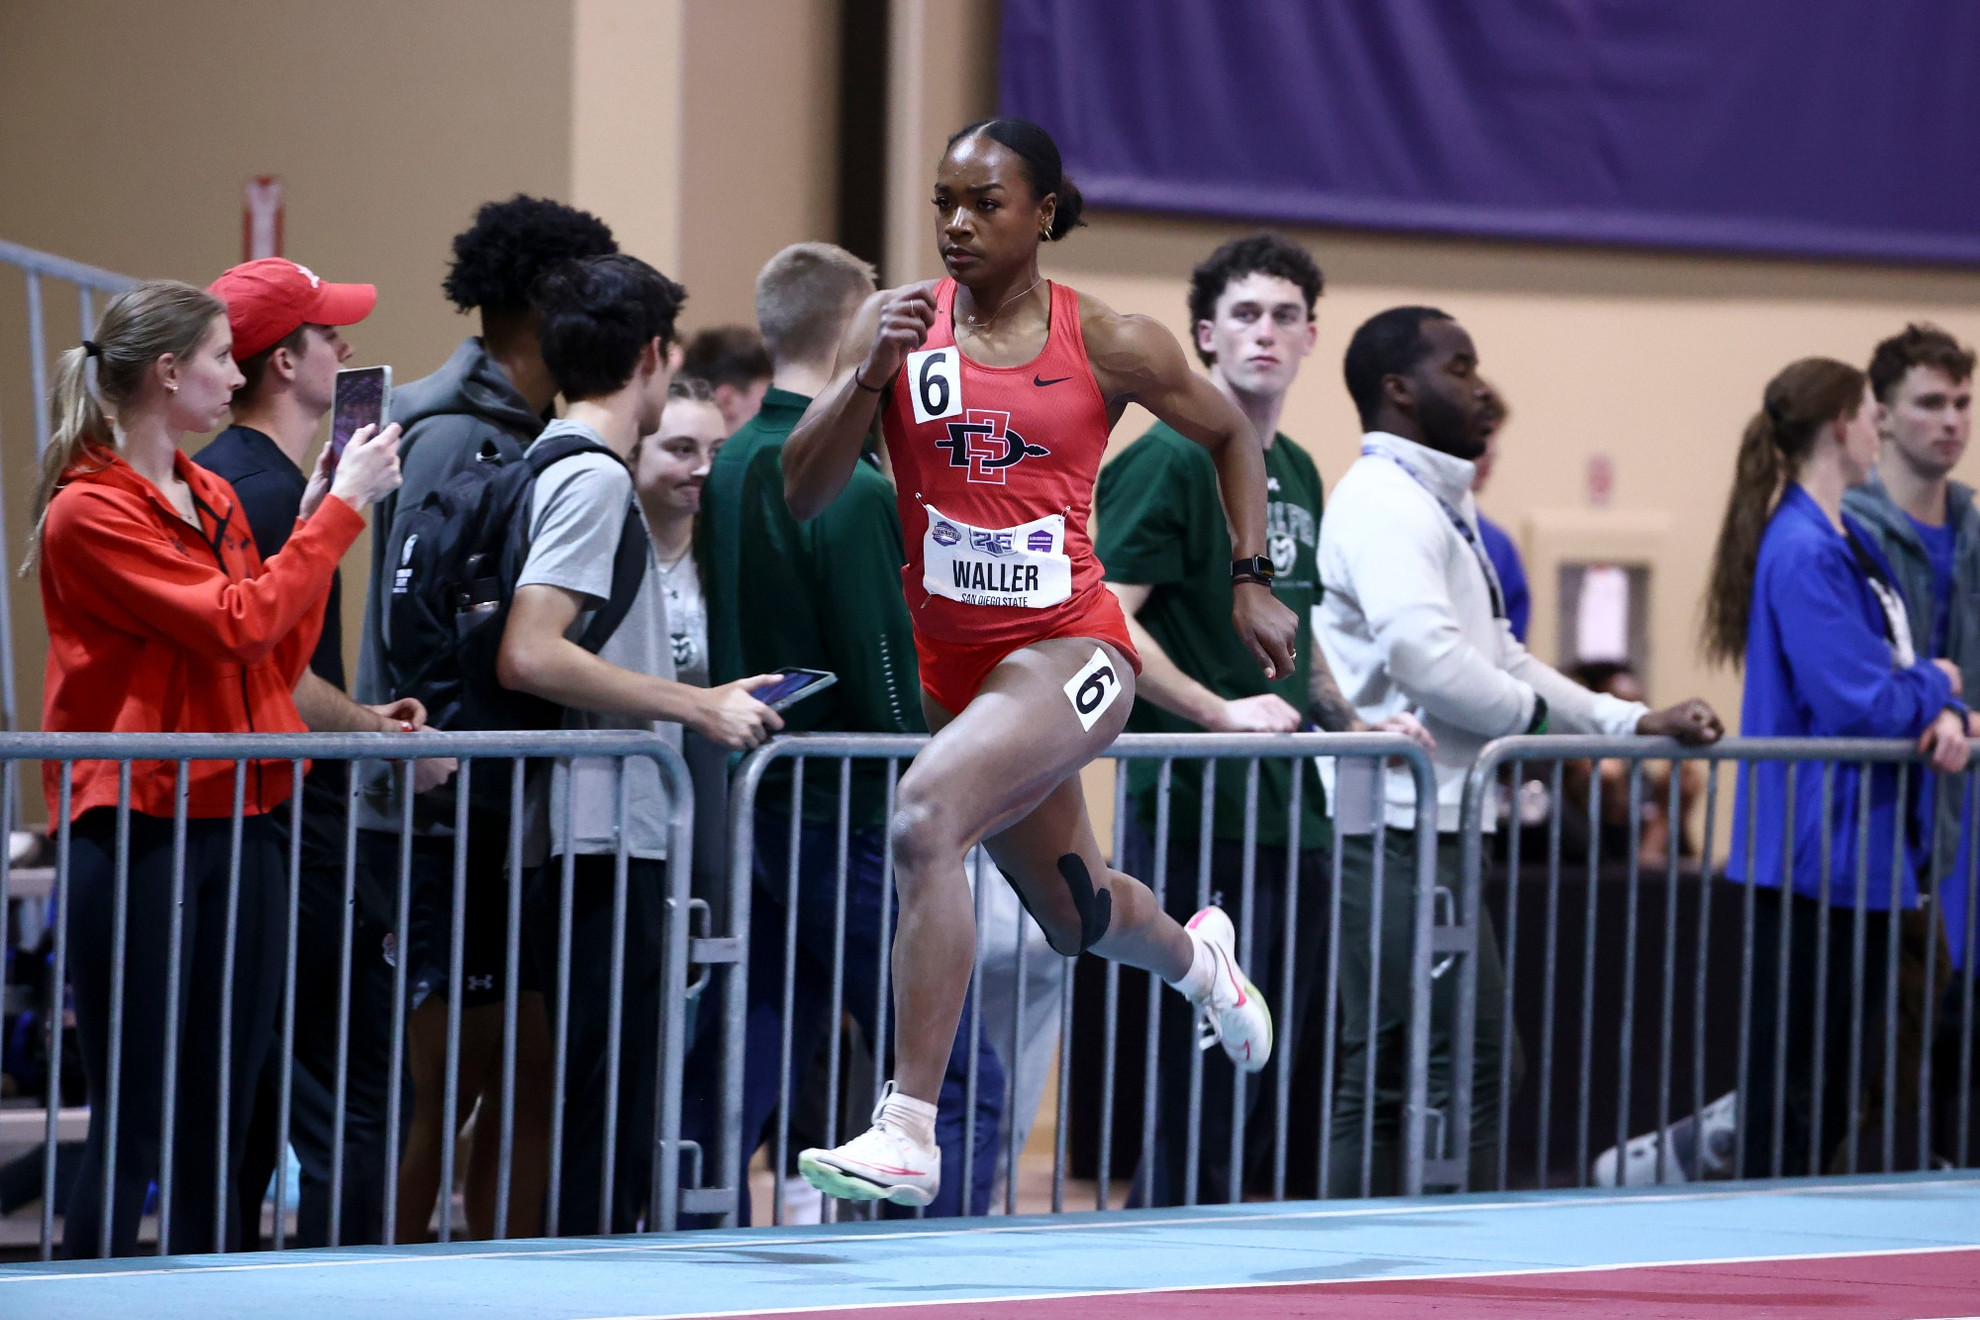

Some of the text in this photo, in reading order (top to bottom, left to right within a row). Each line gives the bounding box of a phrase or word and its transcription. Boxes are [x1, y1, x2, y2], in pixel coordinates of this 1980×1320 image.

[919, 352, 950, 416] 6
[973, 530, 1012, 550] 25
[952, 559, 1039, 592] WALLER
[960, 592, 1029, 608] SAN DIEGO STATE
[1076, 665, 1115, 714] 6
